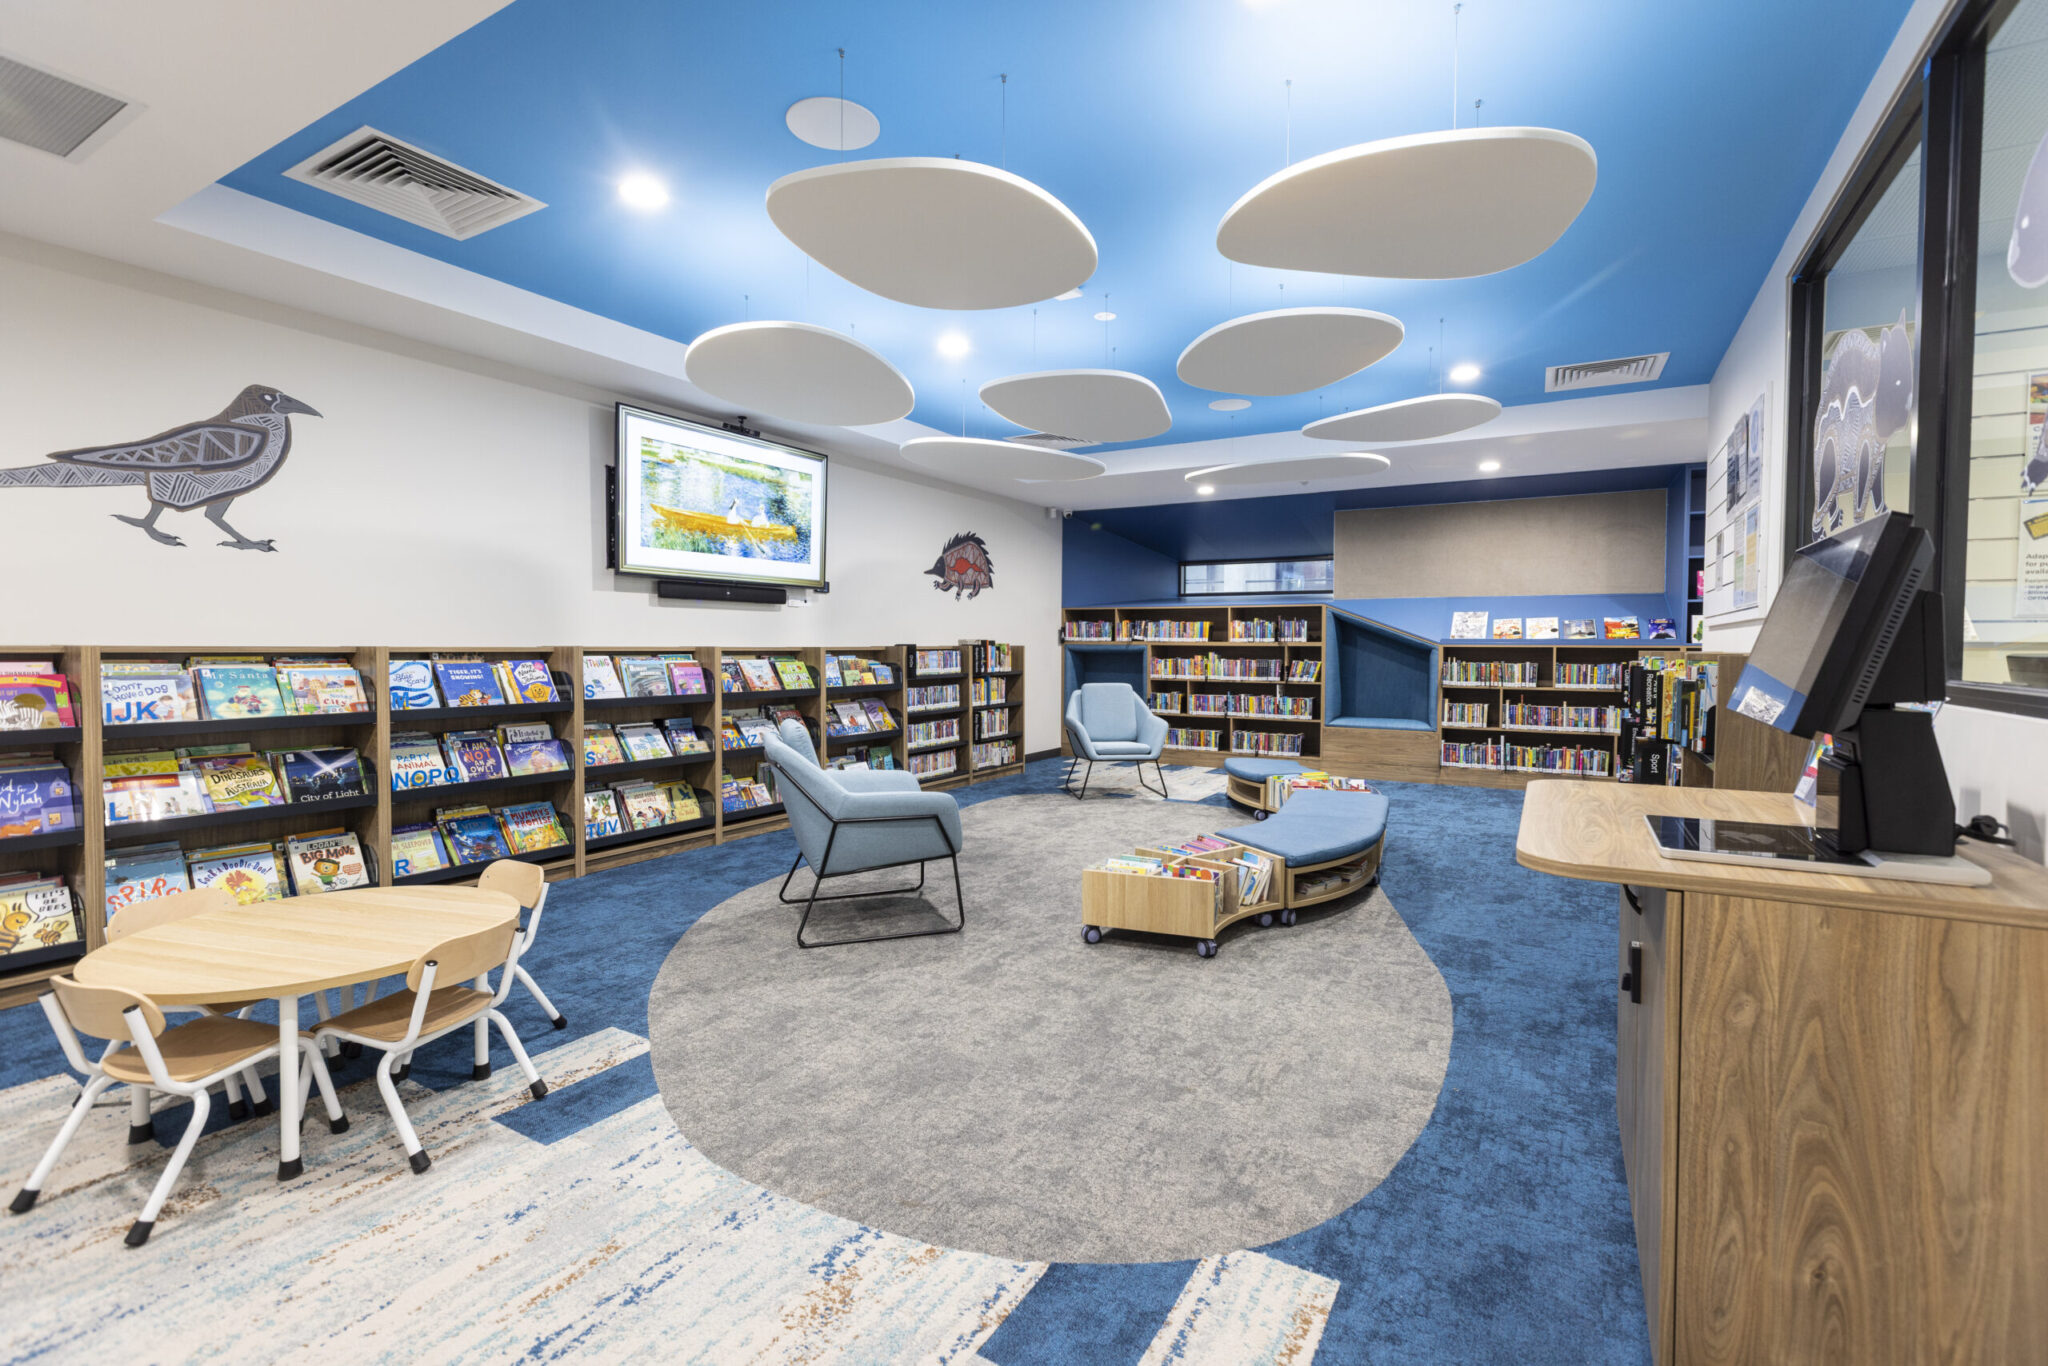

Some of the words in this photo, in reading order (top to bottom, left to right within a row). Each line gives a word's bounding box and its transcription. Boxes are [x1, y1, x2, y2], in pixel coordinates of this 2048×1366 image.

[145, 684, 168, 696] Dog
[585, 684, 595, 698] S
[722, 679, 734, 692] W
[1645, 673, 1654, 706] Recreation
[106, 701, 159, 722] IJK
[723, 733, 757, 749] WXYZ
[396, 752, 430, 763] PARTY
[465, 748, 491, 762] NOT
[586, 751, 596, 765] S
[397, 760, 437, 770] ANIMAL
[1650, 753, 1660, 774] Sport
[210, 768, 266, 785] DINOSAURS
[393, 766, 460, 792] NOPQ
[224, 779, 269, 797] AUSTRALIA
[301, 794, 320, 802] City
[323, 791, 333, 800] of
[335, 789, 360, 798] Light
[109, 802, 129, 821] L
[510, 807, 550, 820] MUMMY'S
[514, 815, 552, 828] PROMISE
[586, 819, 618, 838] TUV
[307, 839, 344, 851] LOGAN'S
[299, 850, 324, 865] BIG
[325, 845, 355, 859] MOVE
[394, 858, 411, 876] R
